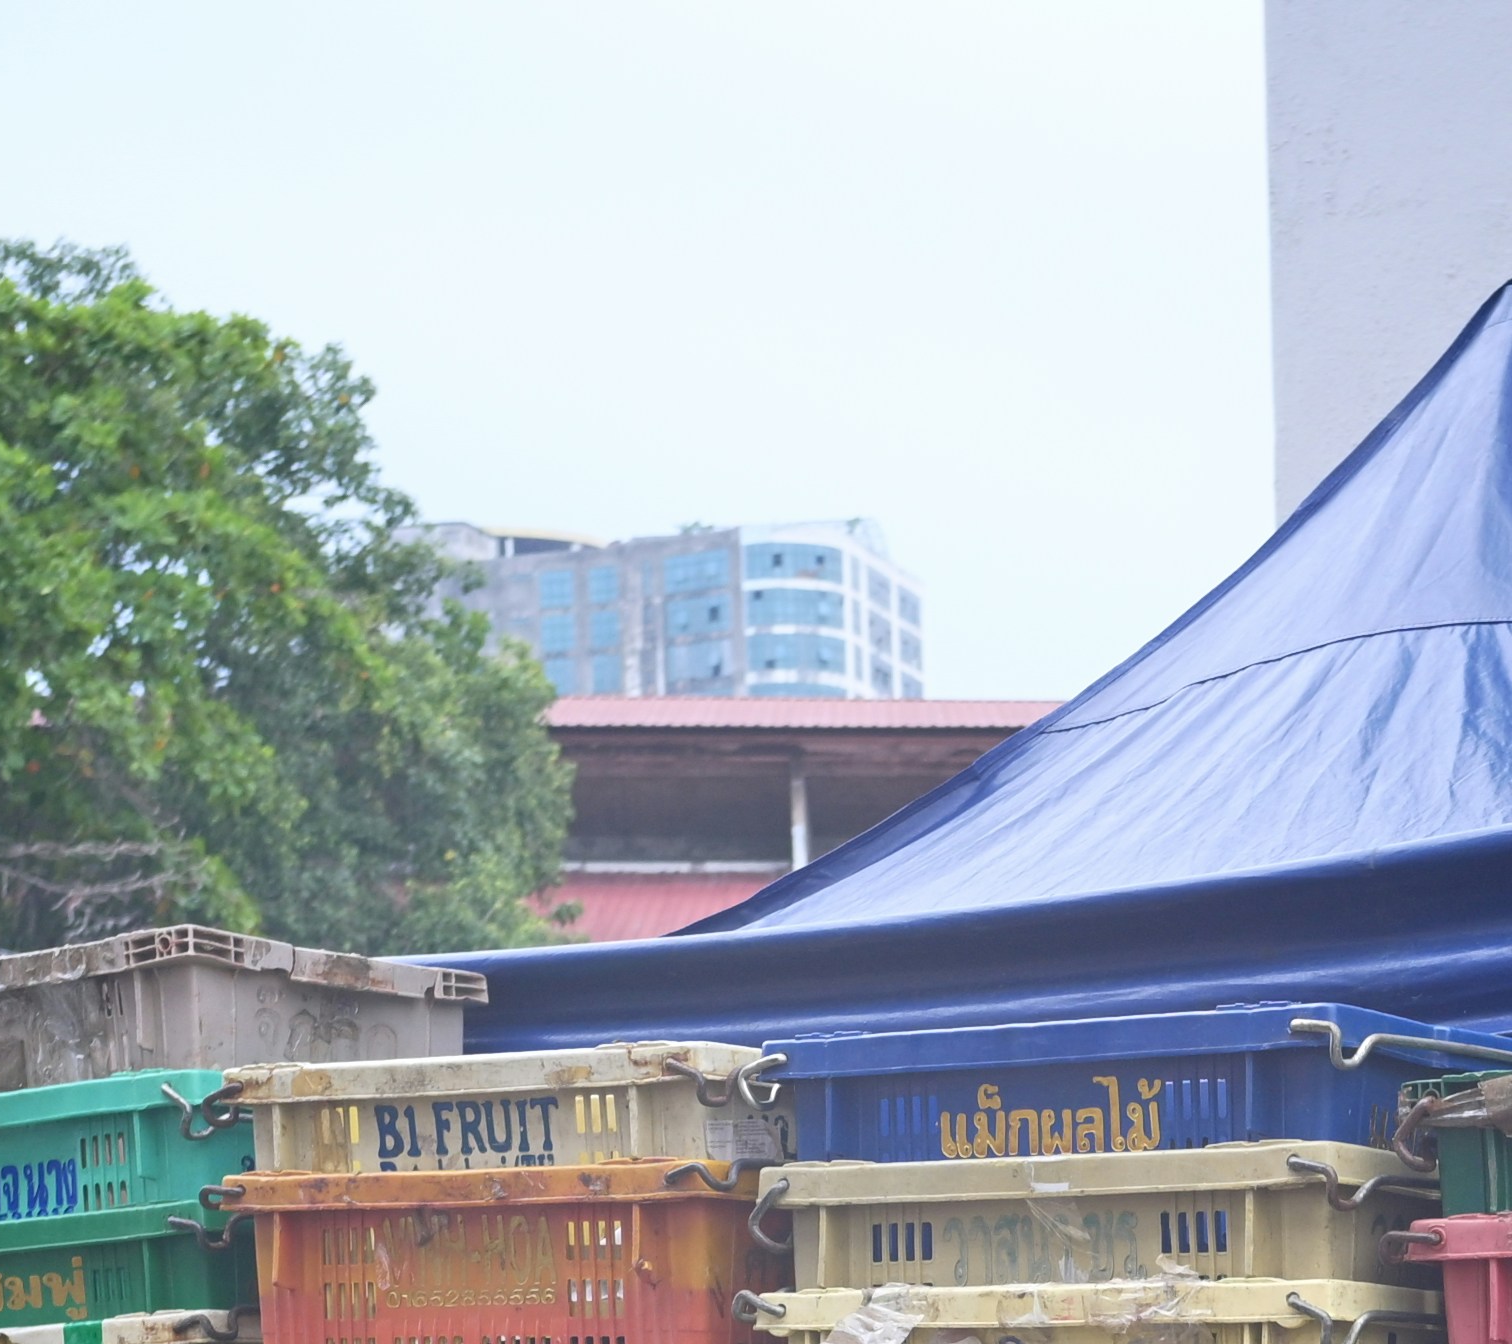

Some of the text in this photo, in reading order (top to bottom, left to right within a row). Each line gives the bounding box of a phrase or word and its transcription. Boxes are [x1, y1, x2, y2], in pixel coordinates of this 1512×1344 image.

[436, 1097, 559, 1157] FRUIT
[941, 1076, 1163, 1159] แม็กผลไม้
